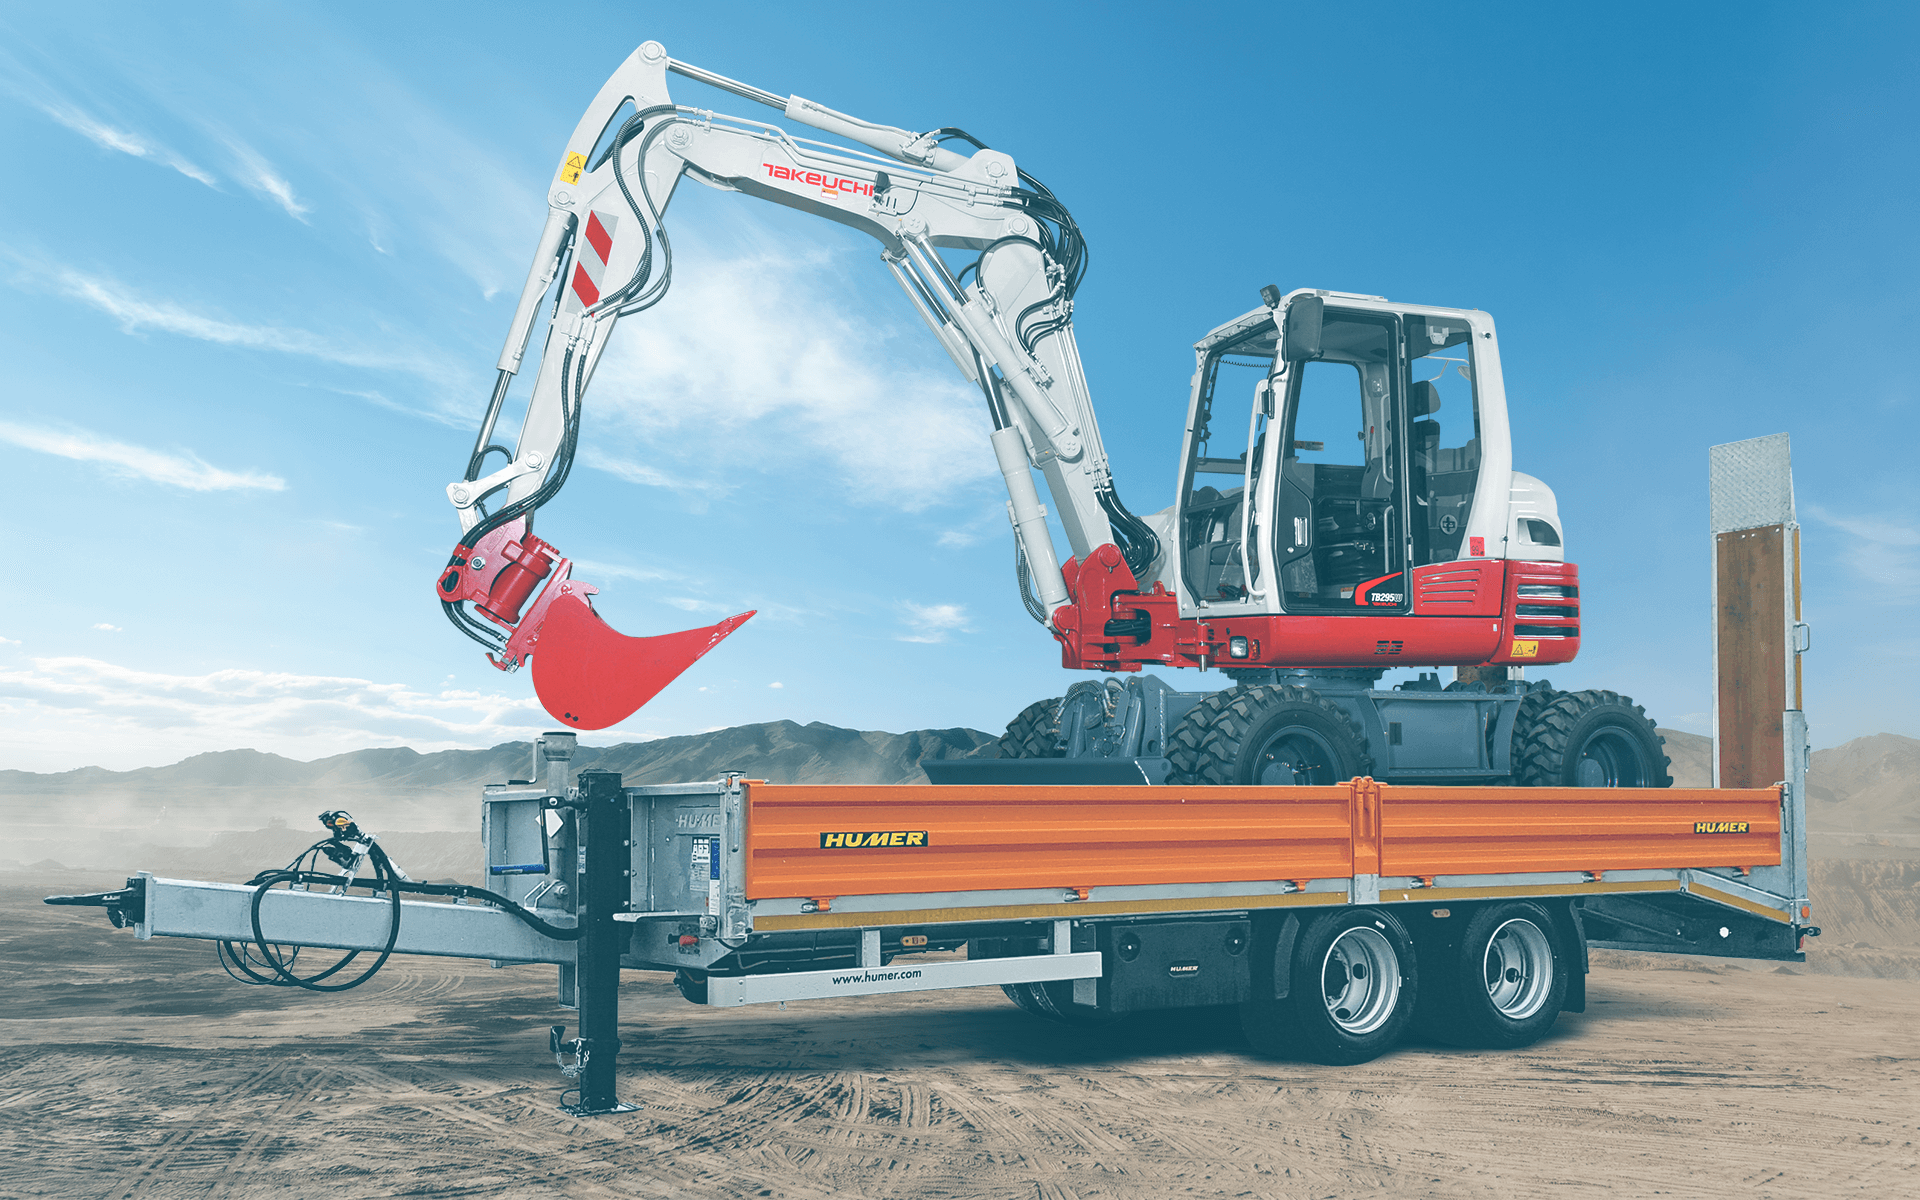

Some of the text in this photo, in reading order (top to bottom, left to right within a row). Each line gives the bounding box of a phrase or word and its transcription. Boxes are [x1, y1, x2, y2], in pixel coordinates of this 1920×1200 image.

[763, 163, 874, 197] TAKEUCHI
[1371, 592, 1403, 602] TB295W
[678, 814, 720, 828] HUME
[1696, 822, 1748, 833] HUMER
[824, 831, 926, 848] HUMER
[832, 970, 922, 985] www.humer.com
